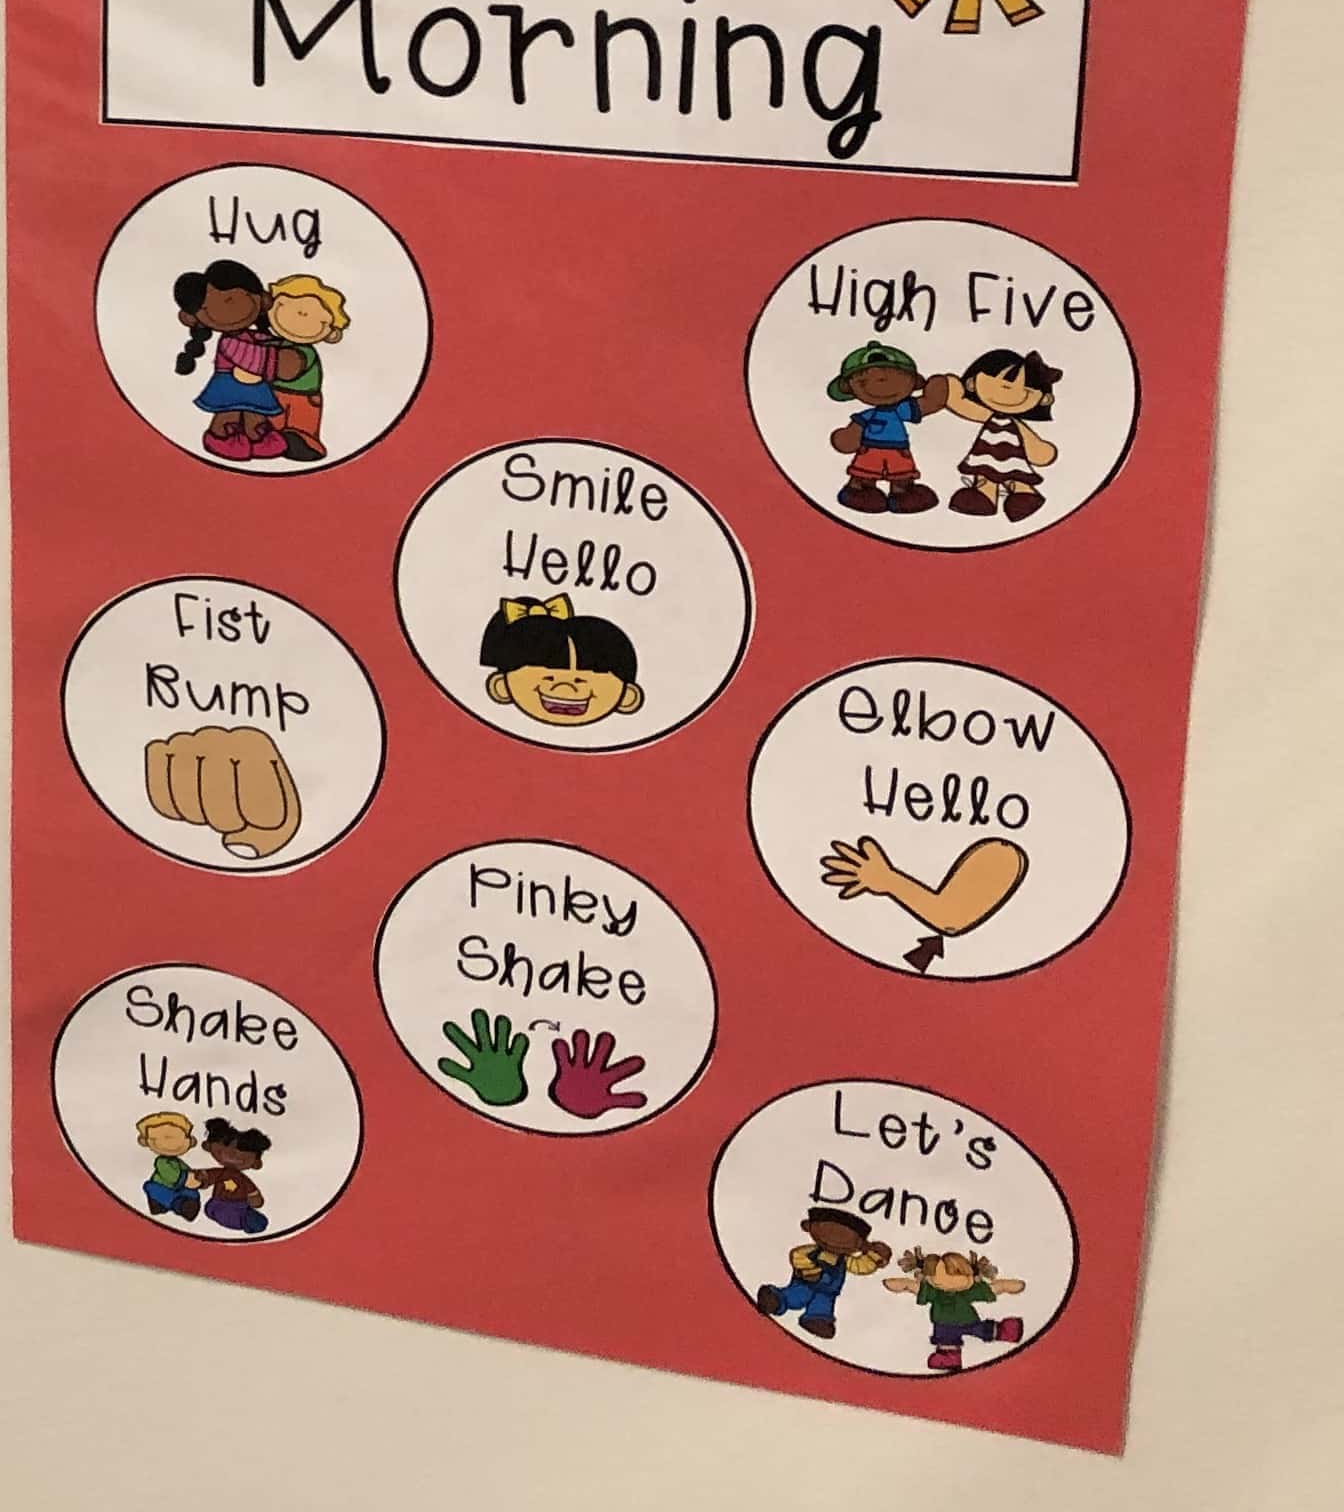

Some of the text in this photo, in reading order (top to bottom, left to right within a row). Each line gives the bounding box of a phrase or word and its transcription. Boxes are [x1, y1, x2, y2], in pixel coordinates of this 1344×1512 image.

[210, 196, 321, 258] Hug
[808, 264, 1094, 332] High Five
[502, 453, 667, 521] Smile
[503, 530, 656, 595] Hello
[175, 593, 269, 644] Fist
[146, 662, 310, 726] Bump
[864, 766, 1028, 829] Hello
[471, 864, 636, 936] Pinky
[458, 936, 645, 1005] Shake
[126, 985, 298, 1050] Shake
[140, 1053, 286, 1115] Hands
[835, 1091, 996, 1170] Let's
[809, 1160, 993, 1244] Dance
